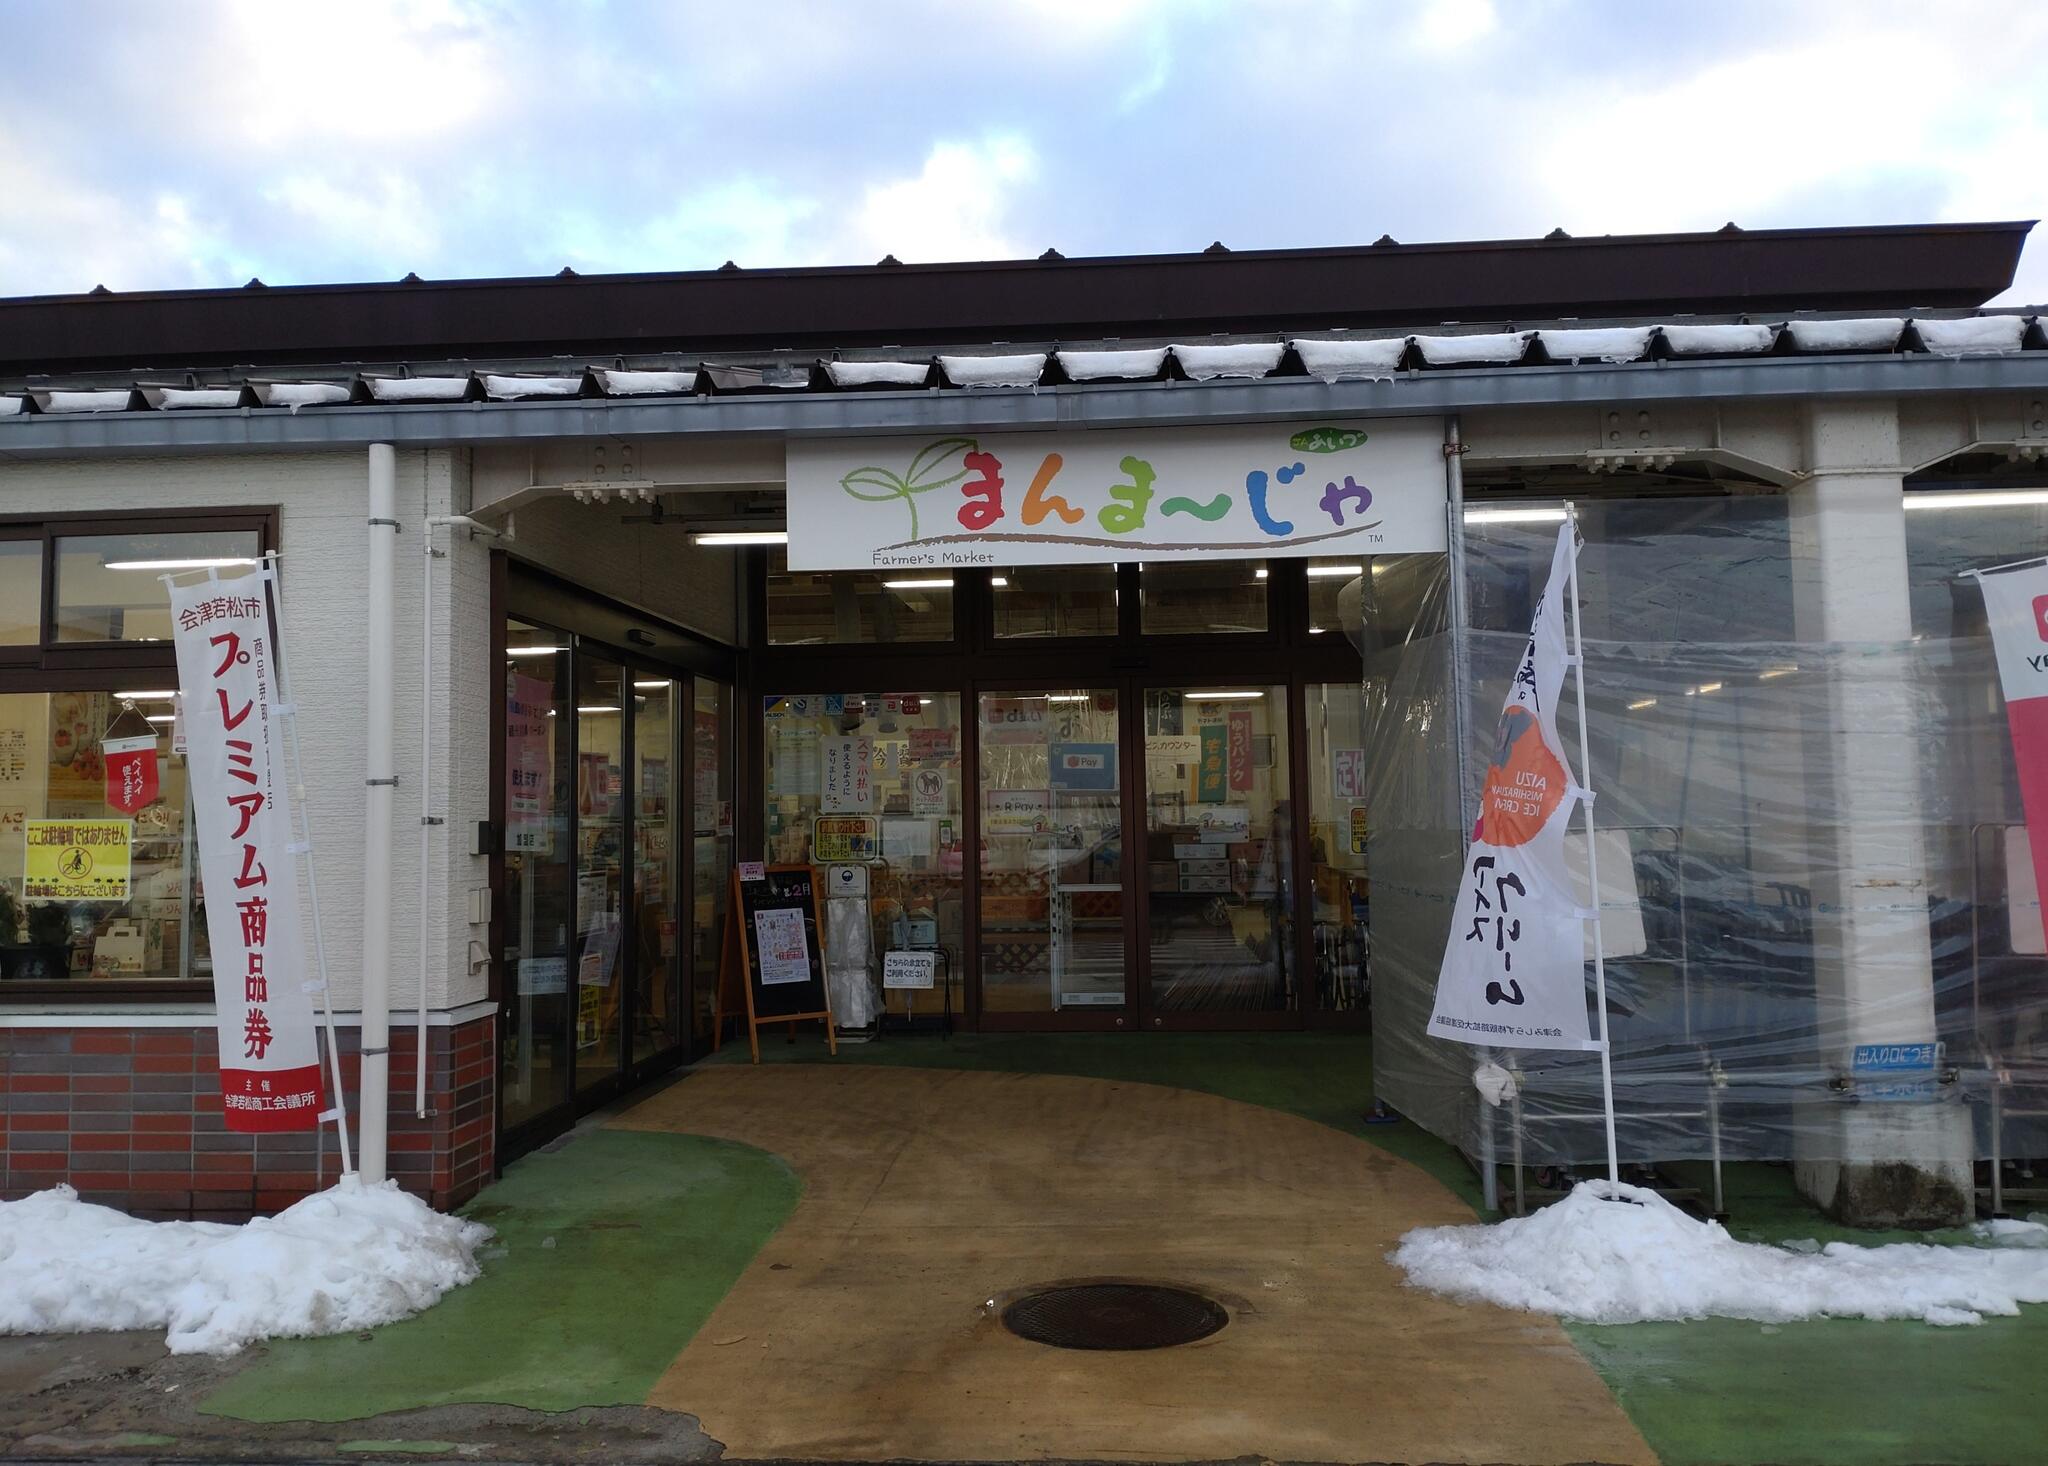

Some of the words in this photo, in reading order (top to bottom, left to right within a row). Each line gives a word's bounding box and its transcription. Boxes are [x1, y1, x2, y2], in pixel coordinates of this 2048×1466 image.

[1368, 535, 1383, 543] TM
[872, 552, 935, 566] Farmer's
[942, 550, 995, 564] Market
[179, 596, 262, 632] 会津若松市
[1231, 719, 1245, 782] ゆうパック
[132, 757, 144, 796] ペイペイ
[828, 748, 838, 792] なりました
[843, 743, 853, 796] 使えるように
[856, 738, 869, 802] スマホ払い
[27, 825, 128, 846] ここは駐輪場ではありません
[209, 631, 274, 1060] プレミアム商品券
[25, 885, 127, 898] 駐輪場はこちらにございます
[1857, 1045, 1931, 1065] 出入り口につき
[225, 1090, 317, 1112] 会津若松商工会議所
